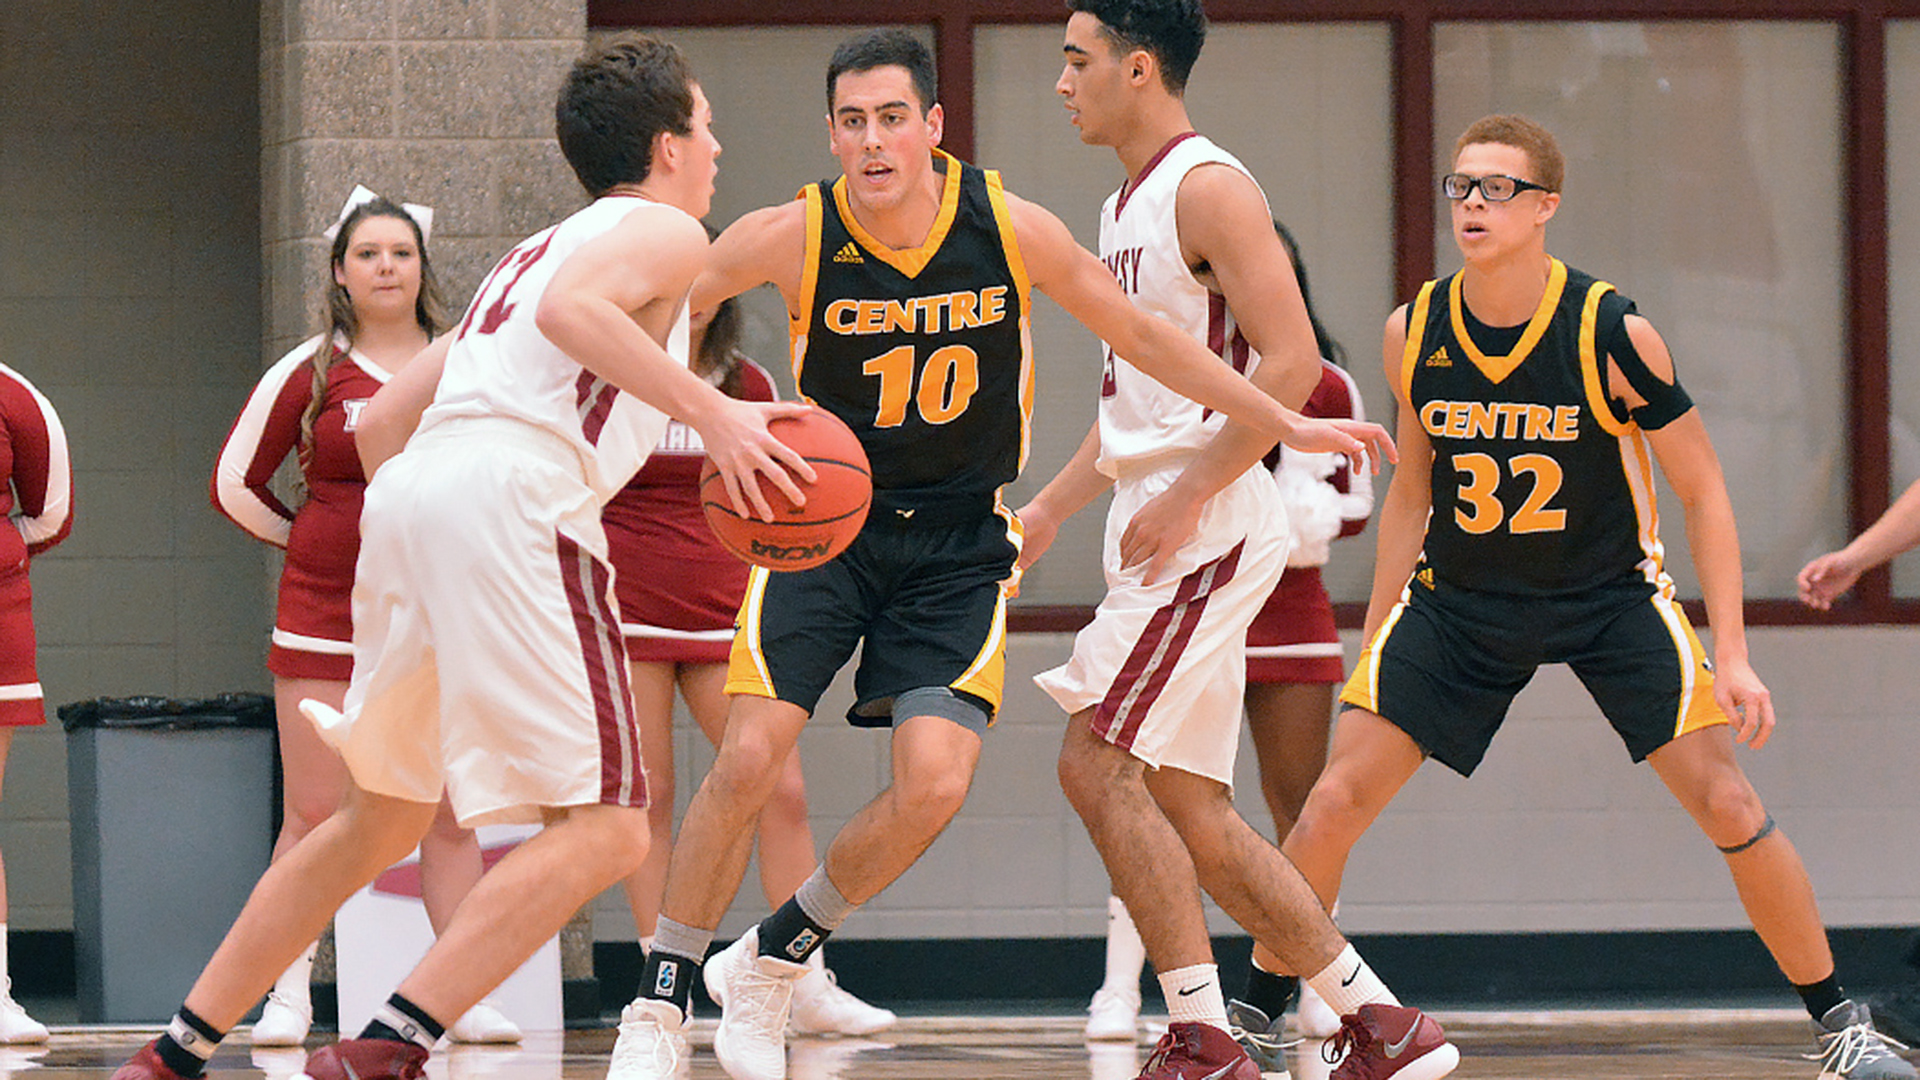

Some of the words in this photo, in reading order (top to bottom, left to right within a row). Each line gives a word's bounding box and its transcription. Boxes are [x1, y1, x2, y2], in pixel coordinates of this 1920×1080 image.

[457, 223, 562, 342] 12
[824, 285, 1008, 335] CENTRE
[862, 344, 979, 428] 10
[1420, 400, 1580, 441] CENTRE
[1452, 452, 1568, 535] 32
[751, 535, 834, 560] NCAA
